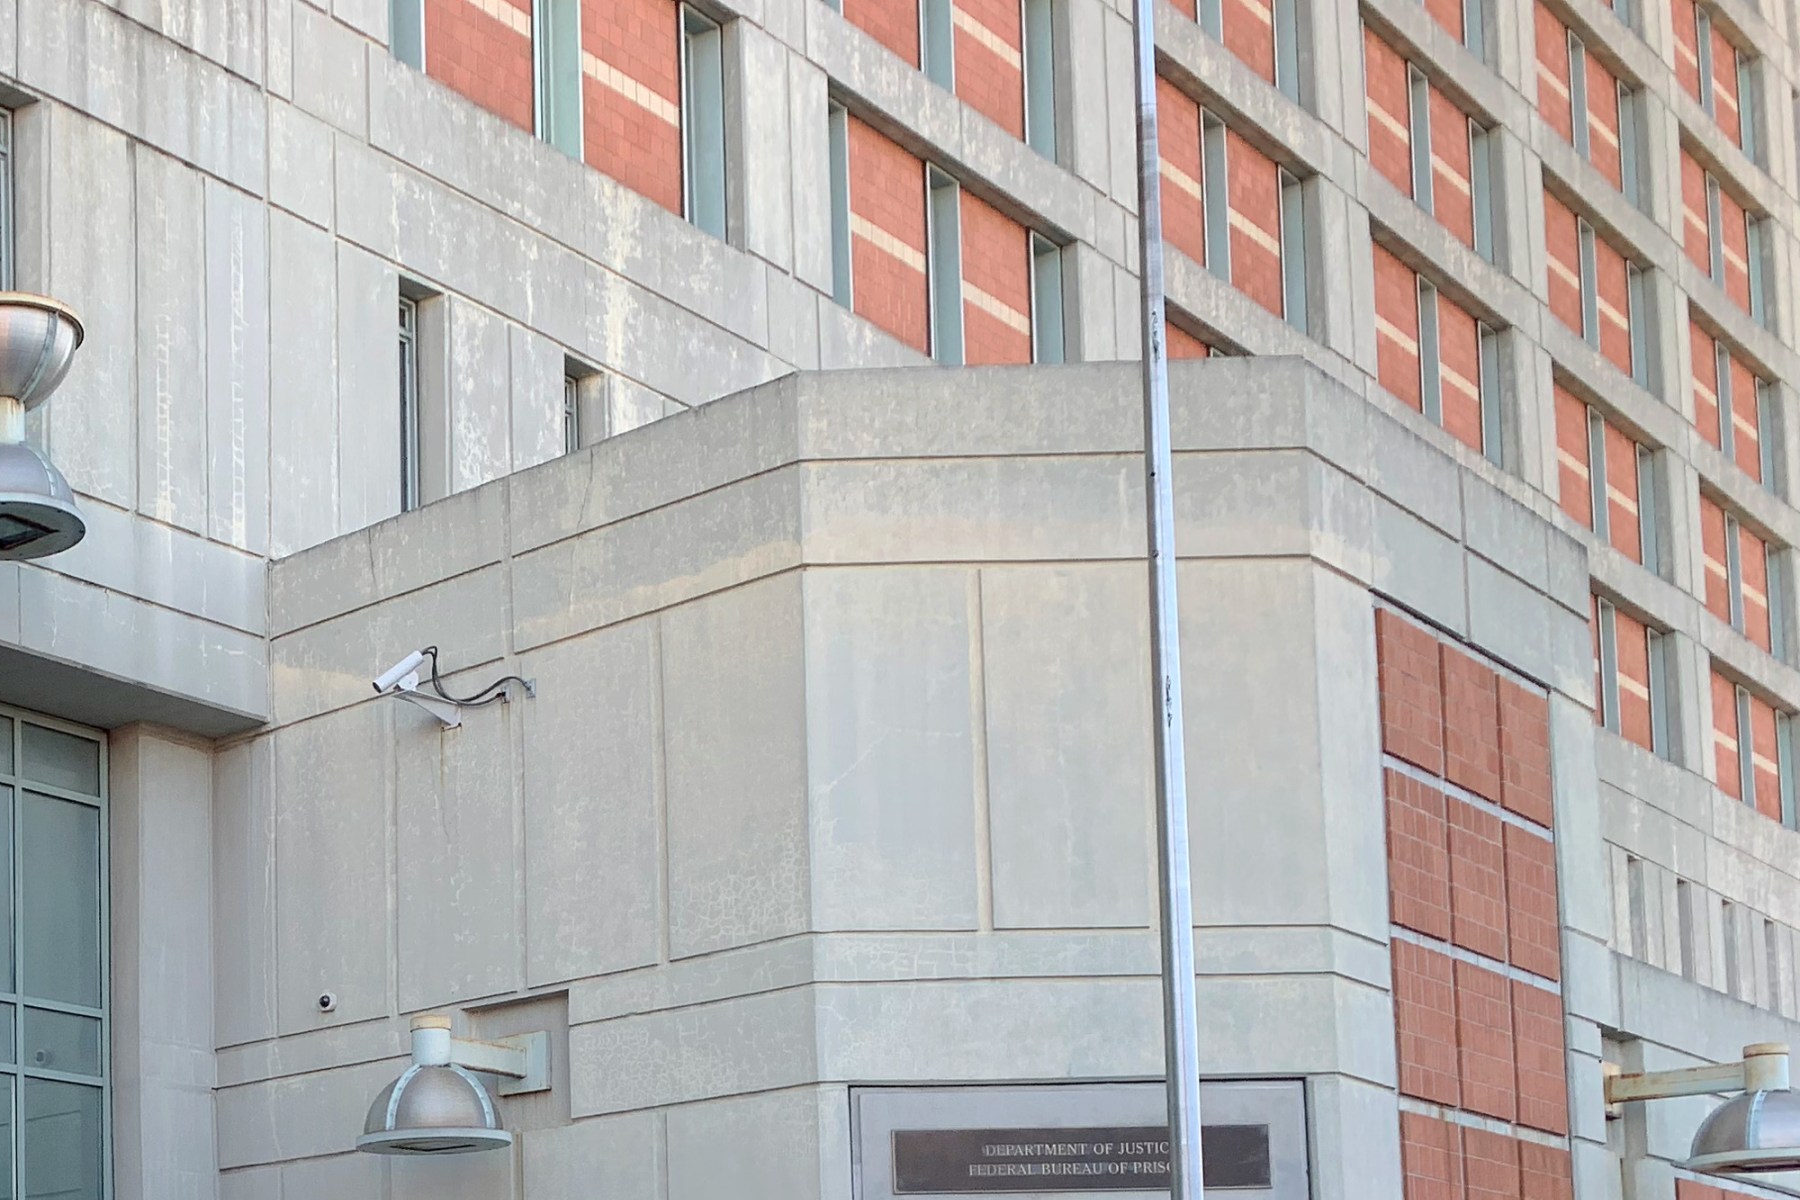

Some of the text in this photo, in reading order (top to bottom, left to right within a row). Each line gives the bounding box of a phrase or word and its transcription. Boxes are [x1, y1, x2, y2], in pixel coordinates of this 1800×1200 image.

[984, 1141, 1170, 1156] DEPARTMENT OF JUSTIC
[969, 1161, 1171, 1176] FEDERAL BUREAU OF PRIS
